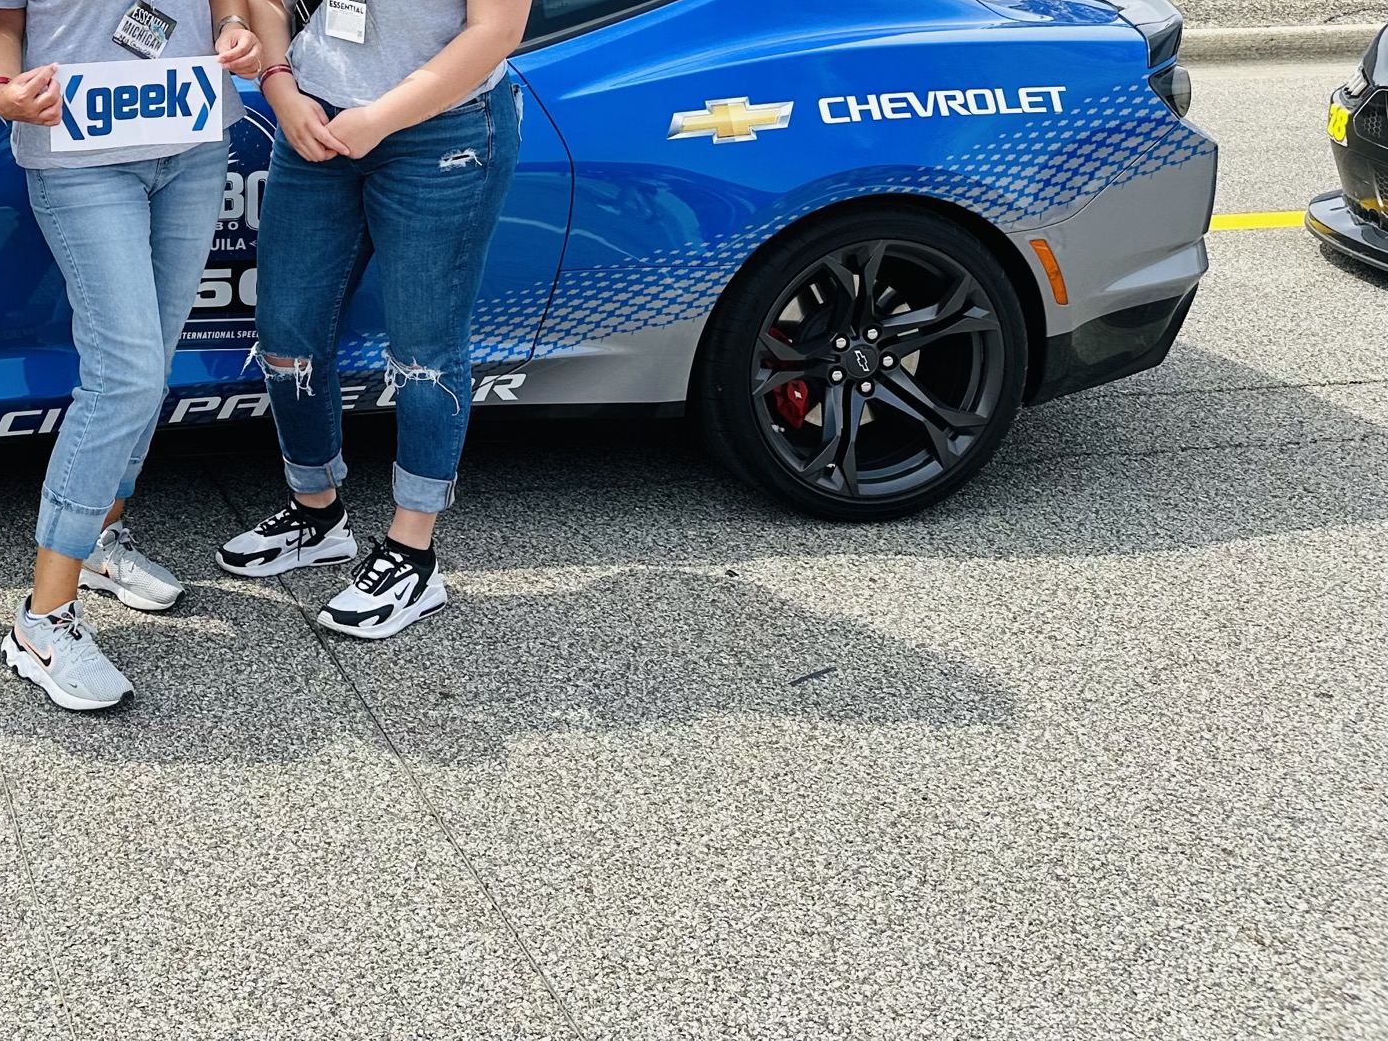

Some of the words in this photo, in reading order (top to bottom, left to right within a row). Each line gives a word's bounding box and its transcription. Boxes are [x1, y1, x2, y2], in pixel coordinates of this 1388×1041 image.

[132, 6, 169, 34] ESSENTIAL
[329, 0, 364, 15] ESSENTIAL
[122, 20, 163, 52] MICHIGAN
[818, 86, 1066, 125] CHEVROLET
[215, 221, 239, 231] BO
[211, 238, 247, 251] UILA
[168, 385, 367, 423] PAE
[376, 373, 526, 406] CR
